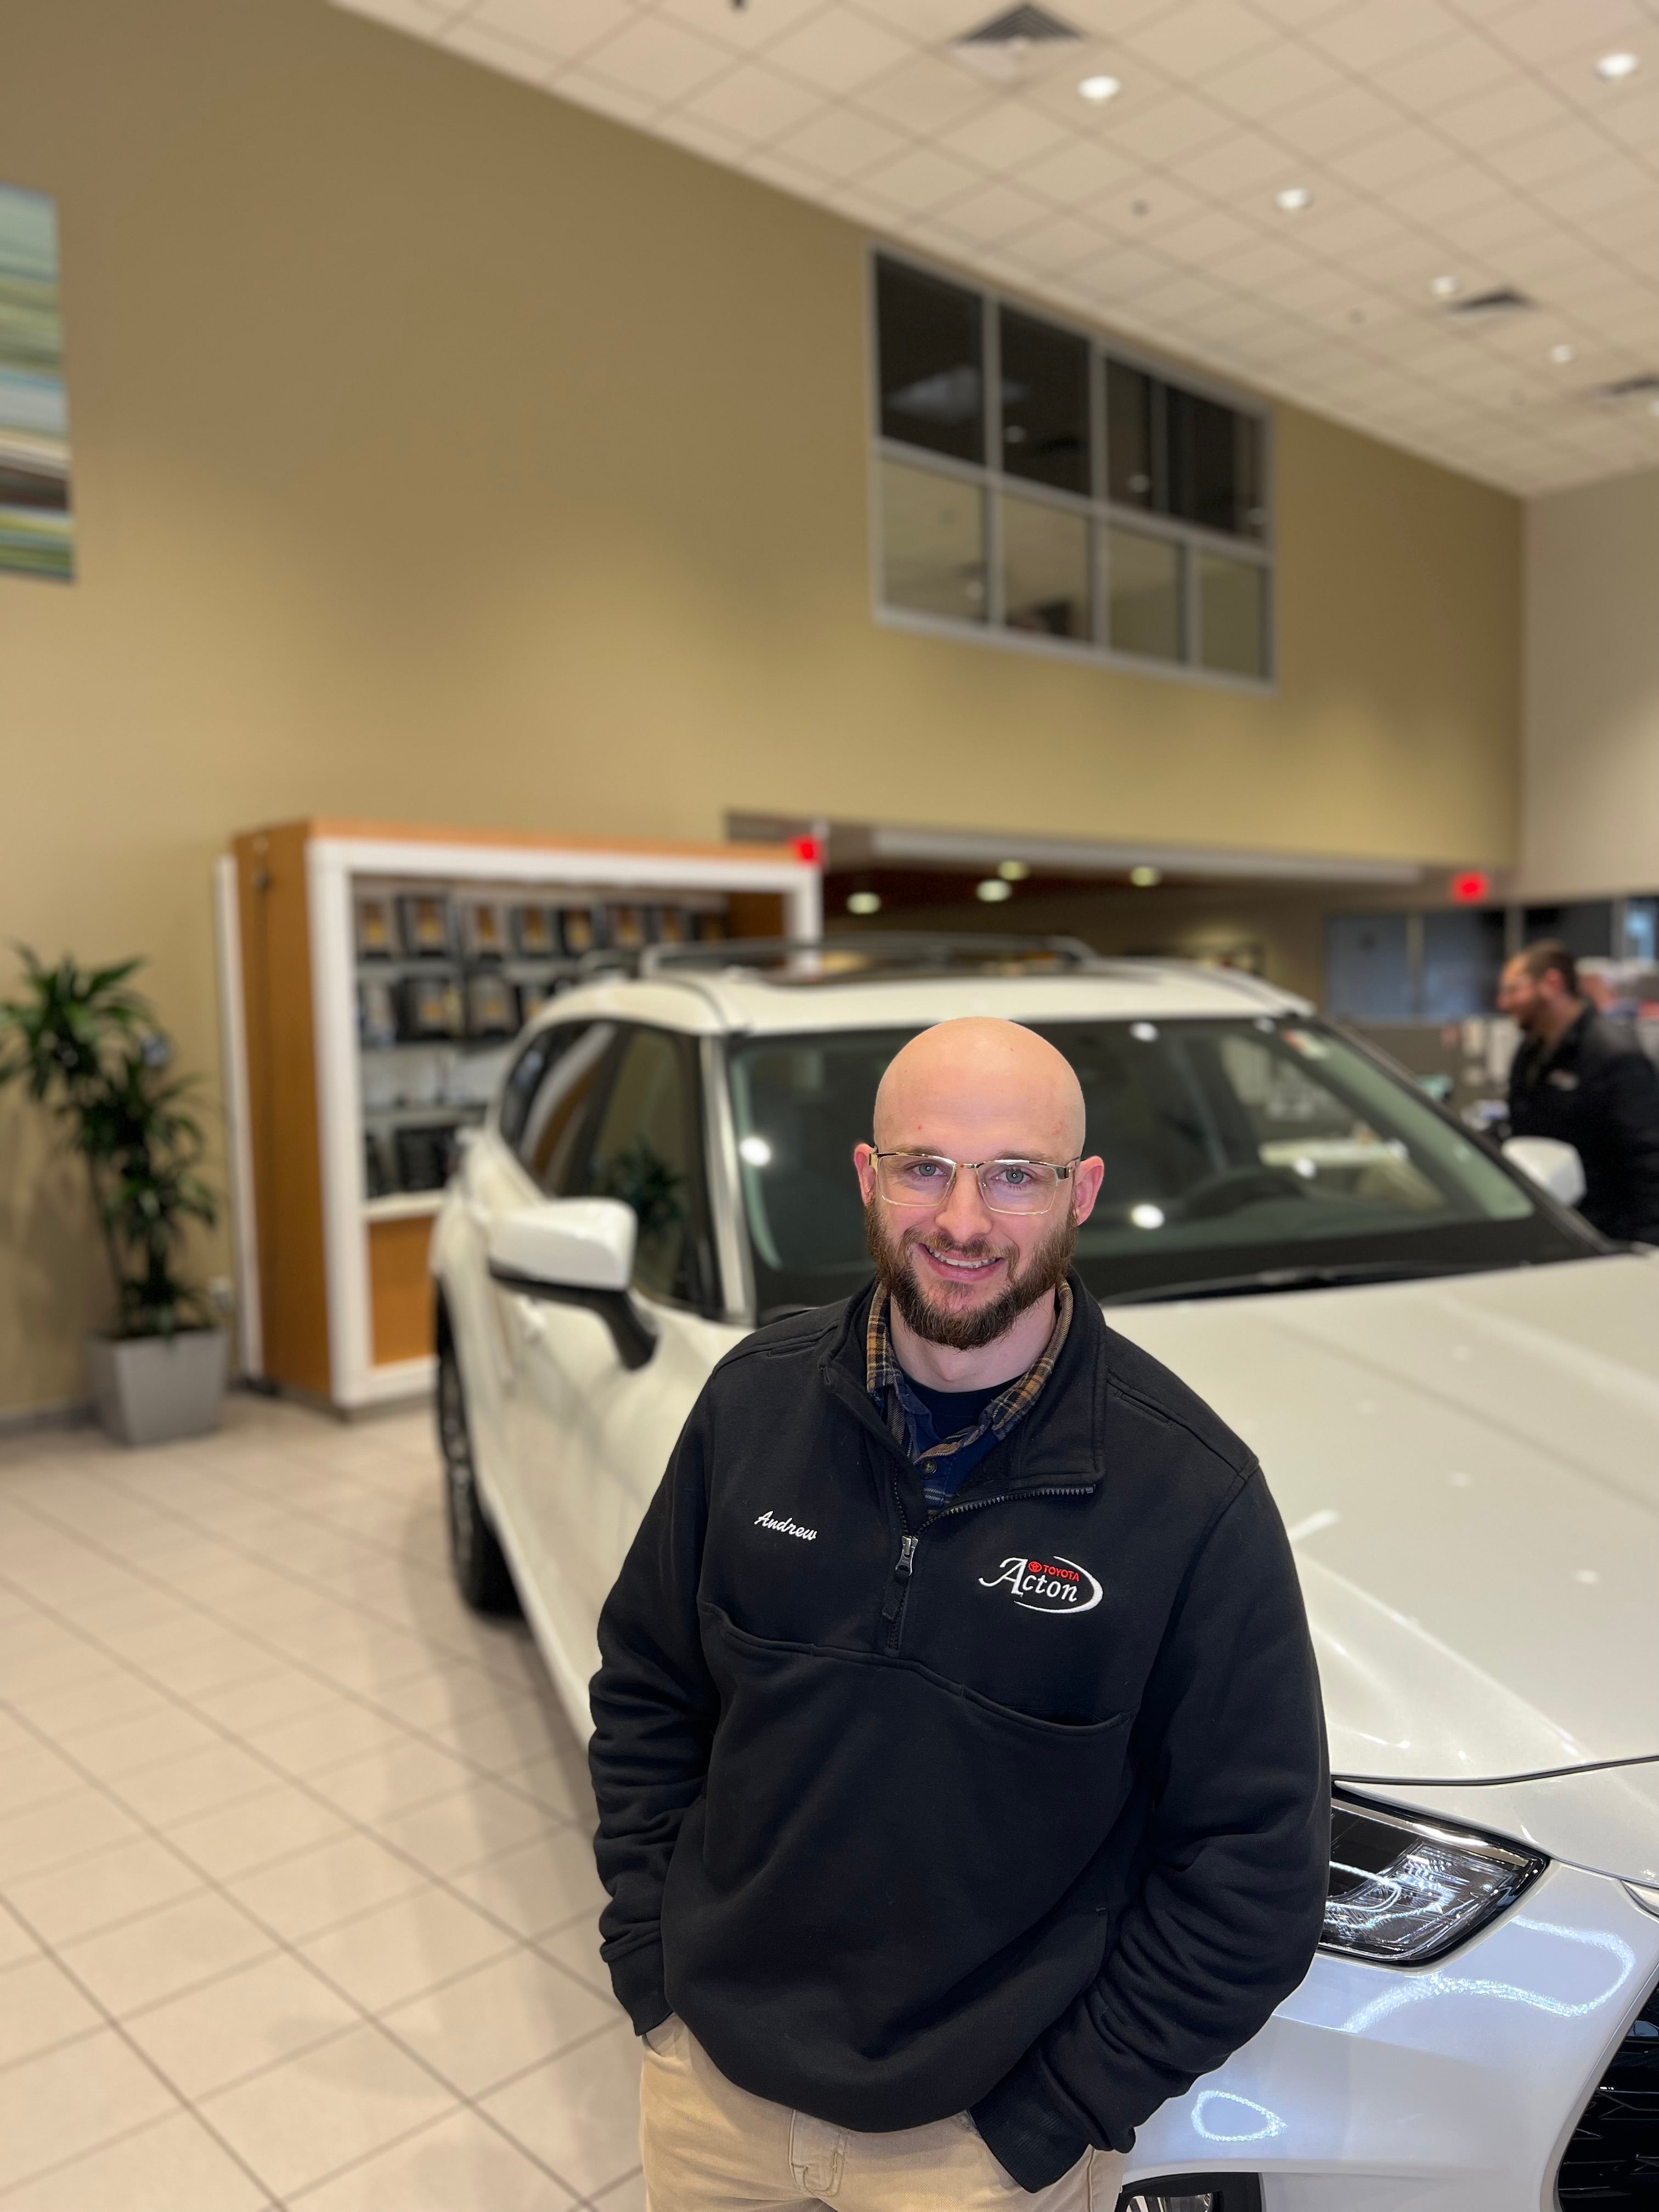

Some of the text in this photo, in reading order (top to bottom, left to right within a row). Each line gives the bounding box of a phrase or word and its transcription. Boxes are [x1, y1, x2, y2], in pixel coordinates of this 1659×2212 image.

[754, 1510, 817, 1541] Andrew
[978, 1557, 1079, 1602] Acton
[1043, 1564, 1080, 1582] TOYOTA
